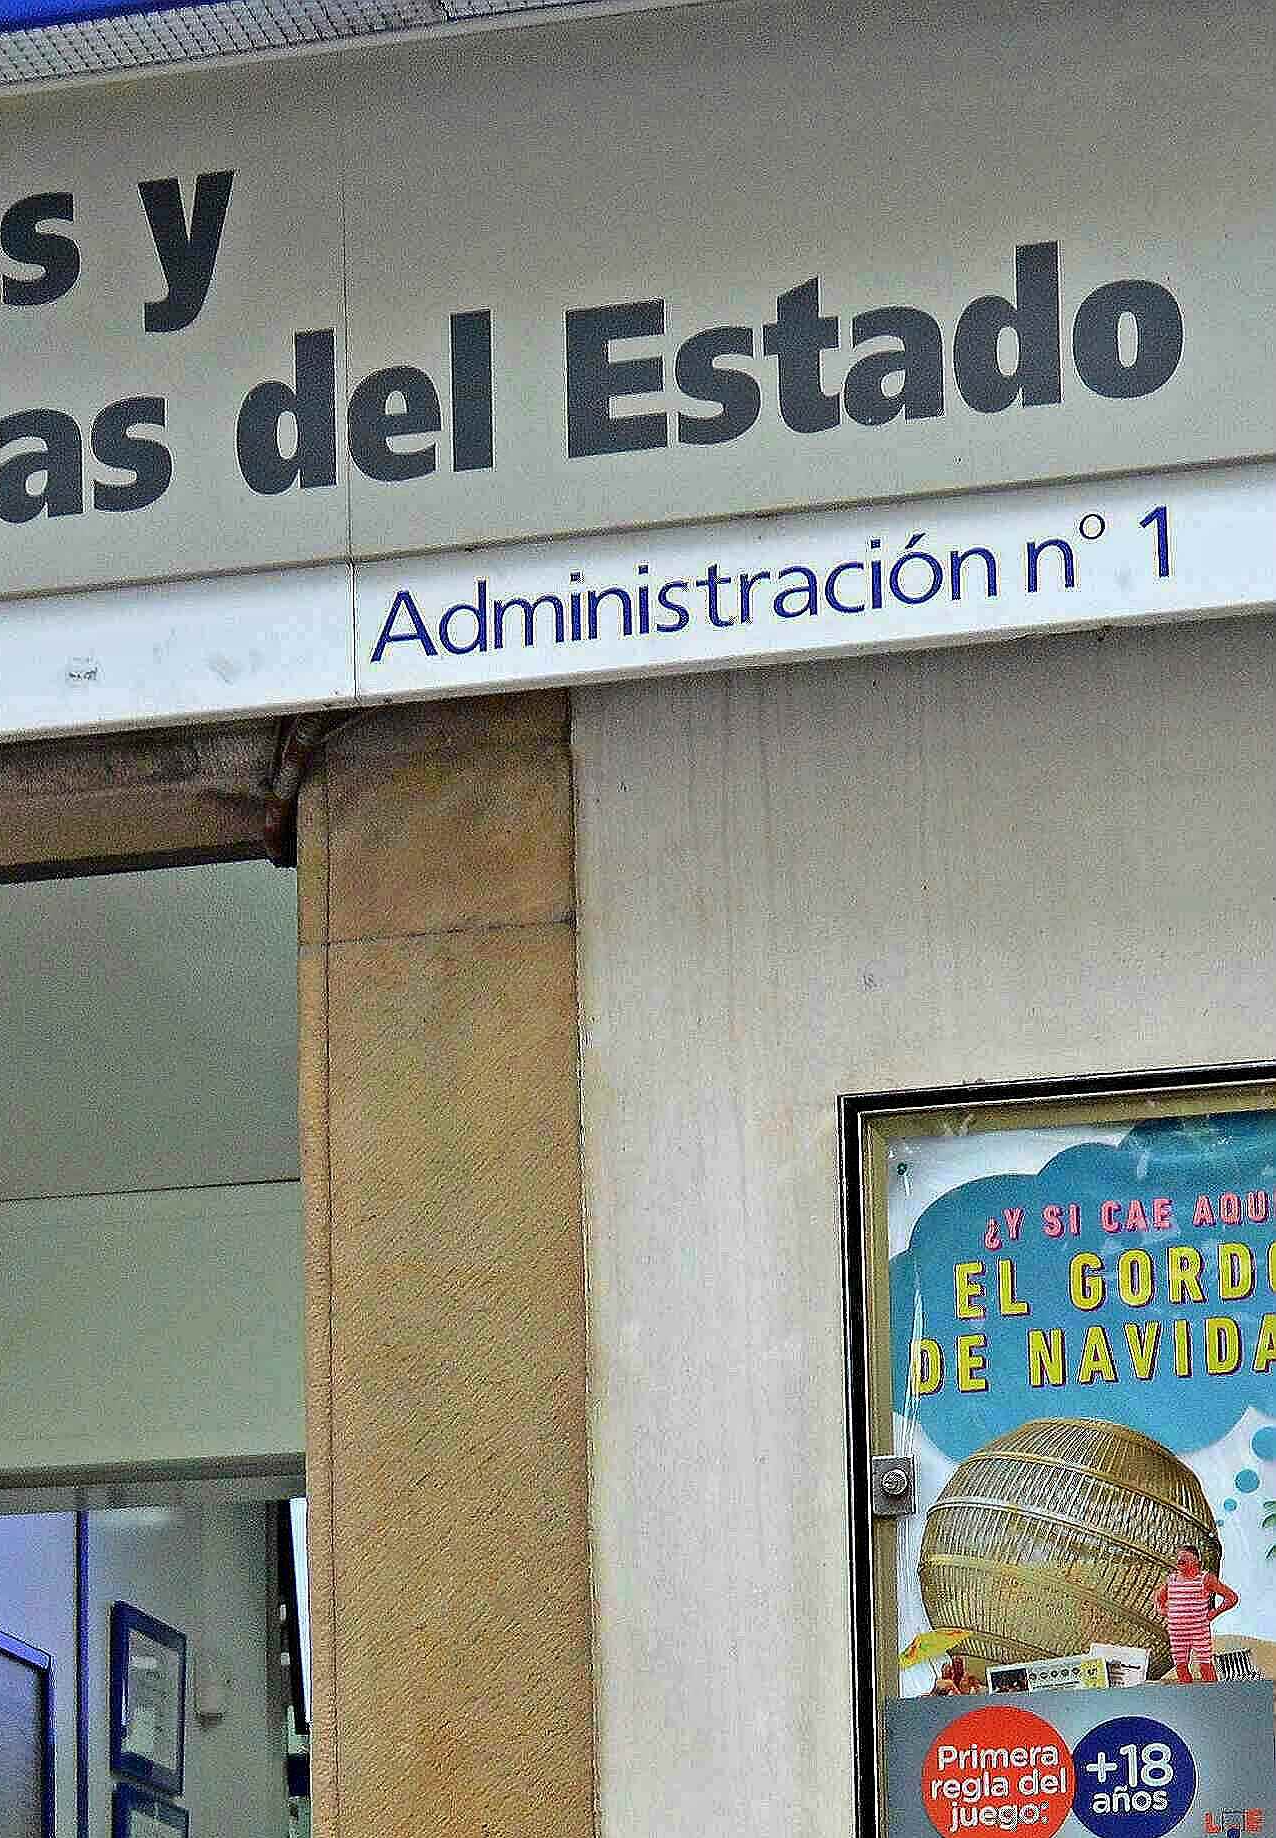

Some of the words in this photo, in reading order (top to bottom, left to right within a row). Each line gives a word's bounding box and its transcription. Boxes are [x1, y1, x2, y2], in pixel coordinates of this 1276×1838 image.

[136, 169, 234, 333] y
[236, 311, 495, 497] del
[566, 242, 1187, 458] Estado
[373, 532, 1001, 665] Administración
[1141, 506, 1175, 579] 1
[985, 1208, 1024, 1250] ¿Y
[1042, 1204, 1081, 1238] SI
[1101, 1198, 1172, 1234] CAE
[1193, 1190, 1276, 1227] AQU
[954, 1260, 1031, 1320] EL
[1069, 1242, 1276, 1311] GORD
[911, 1335, 990, 1395] DE
[930, 1773, 1009, 1801] regla
[1019, 1769, 1067, 1794] del
[937, 1745, 1059, 1771] Primera
[1087, 1744, 1174, 1788] +18
[949, 1801, 1050, 1832] juego:
[1093, 1786, 1169, 1814] años
